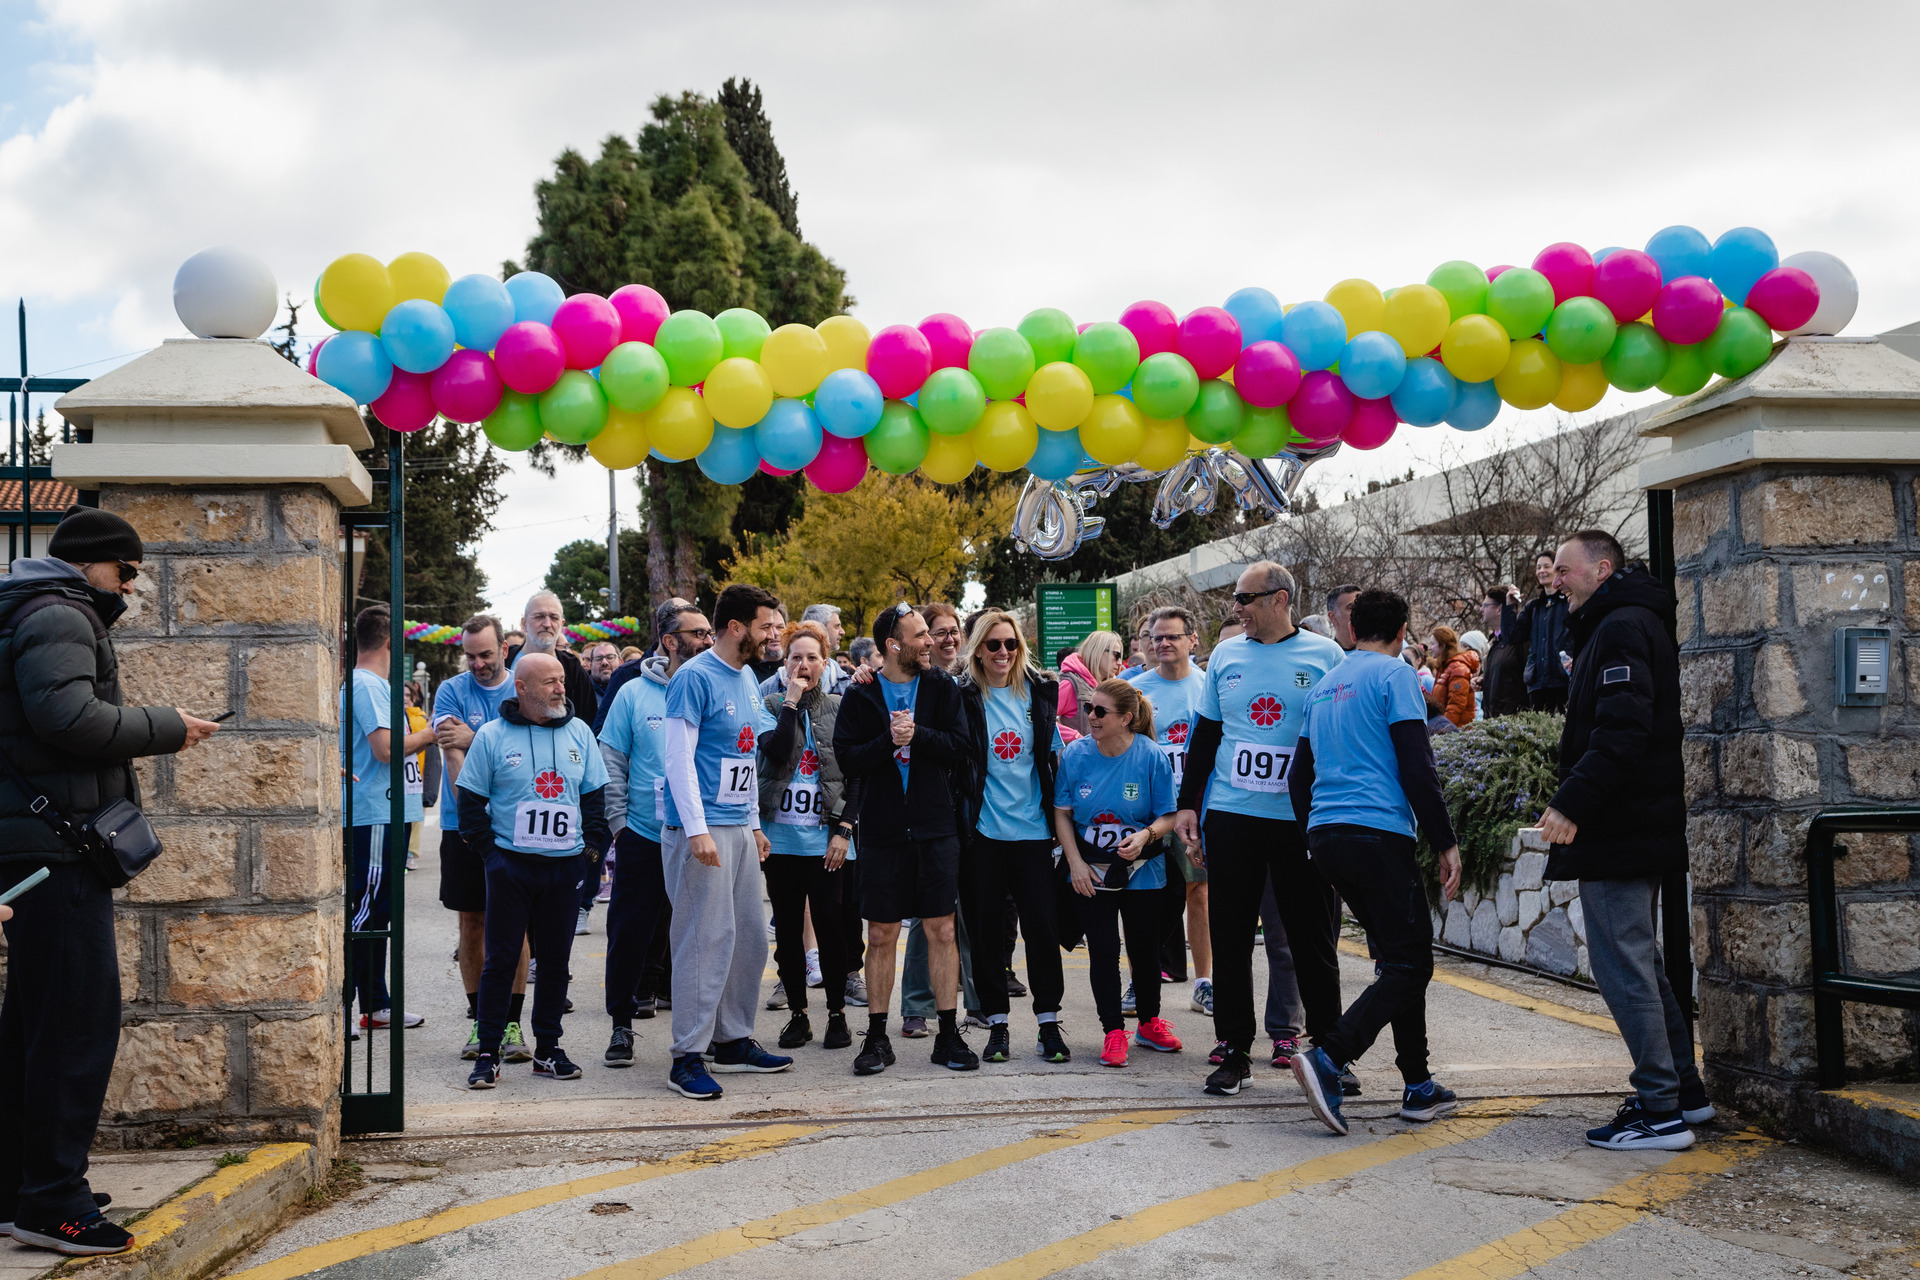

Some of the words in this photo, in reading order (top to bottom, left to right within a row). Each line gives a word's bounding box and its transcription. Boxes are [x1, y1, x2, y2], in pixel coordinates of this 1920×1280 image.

[1167, 752, 1184, 773] 11
[1237, 749, 1291, 780] 097
[780, 788, 822, 815] 096
[526, 809, 569, 837] 116
